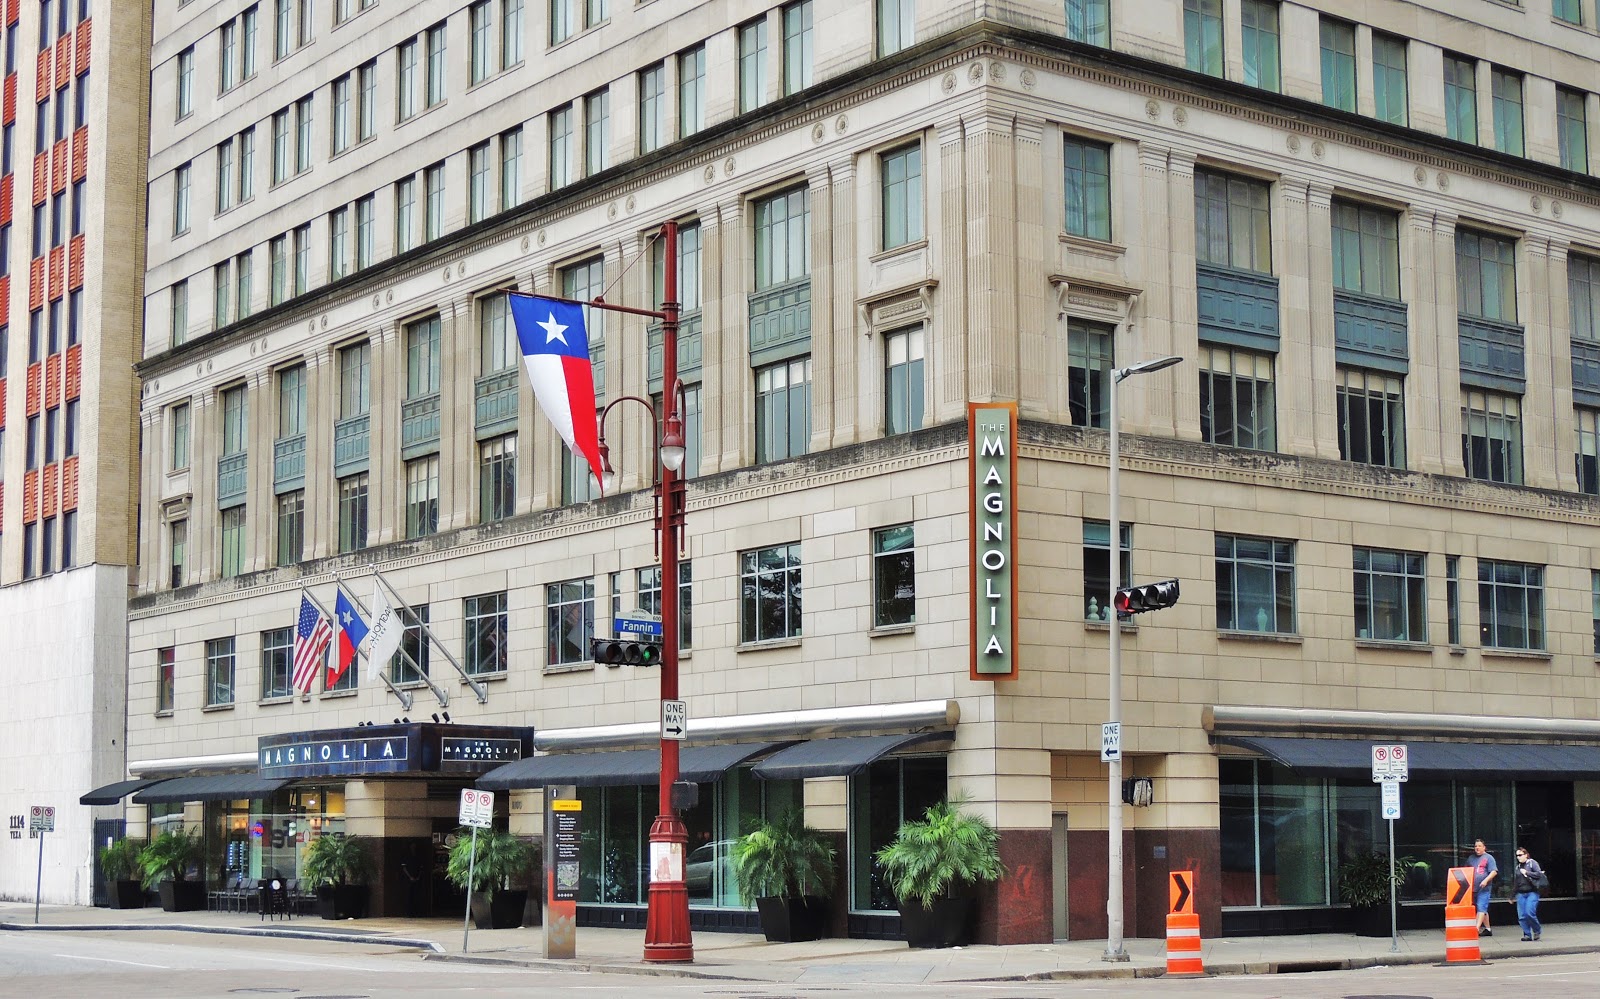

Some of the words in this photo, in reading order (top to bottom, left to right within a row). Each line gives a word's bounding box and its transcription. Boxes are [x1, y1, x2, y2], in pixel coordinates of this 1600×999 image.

[980, 424, 1005, 432] THE
[980, 435, 1005, 654] MAGNOLIA
[622, 620, 654, 633] Fannin
[665, 703, 684, 714] ONE
[665, 714, 684, 724] WAY
[1103, 725, 1119, 735] ONE
[1103, 735, 1119, 746] WAY
[264, 740, 394, 765] MAGNOLIA
[444, 746, 518, 754] MAGNOLIA
[10, 815, 24, 828] 1114
